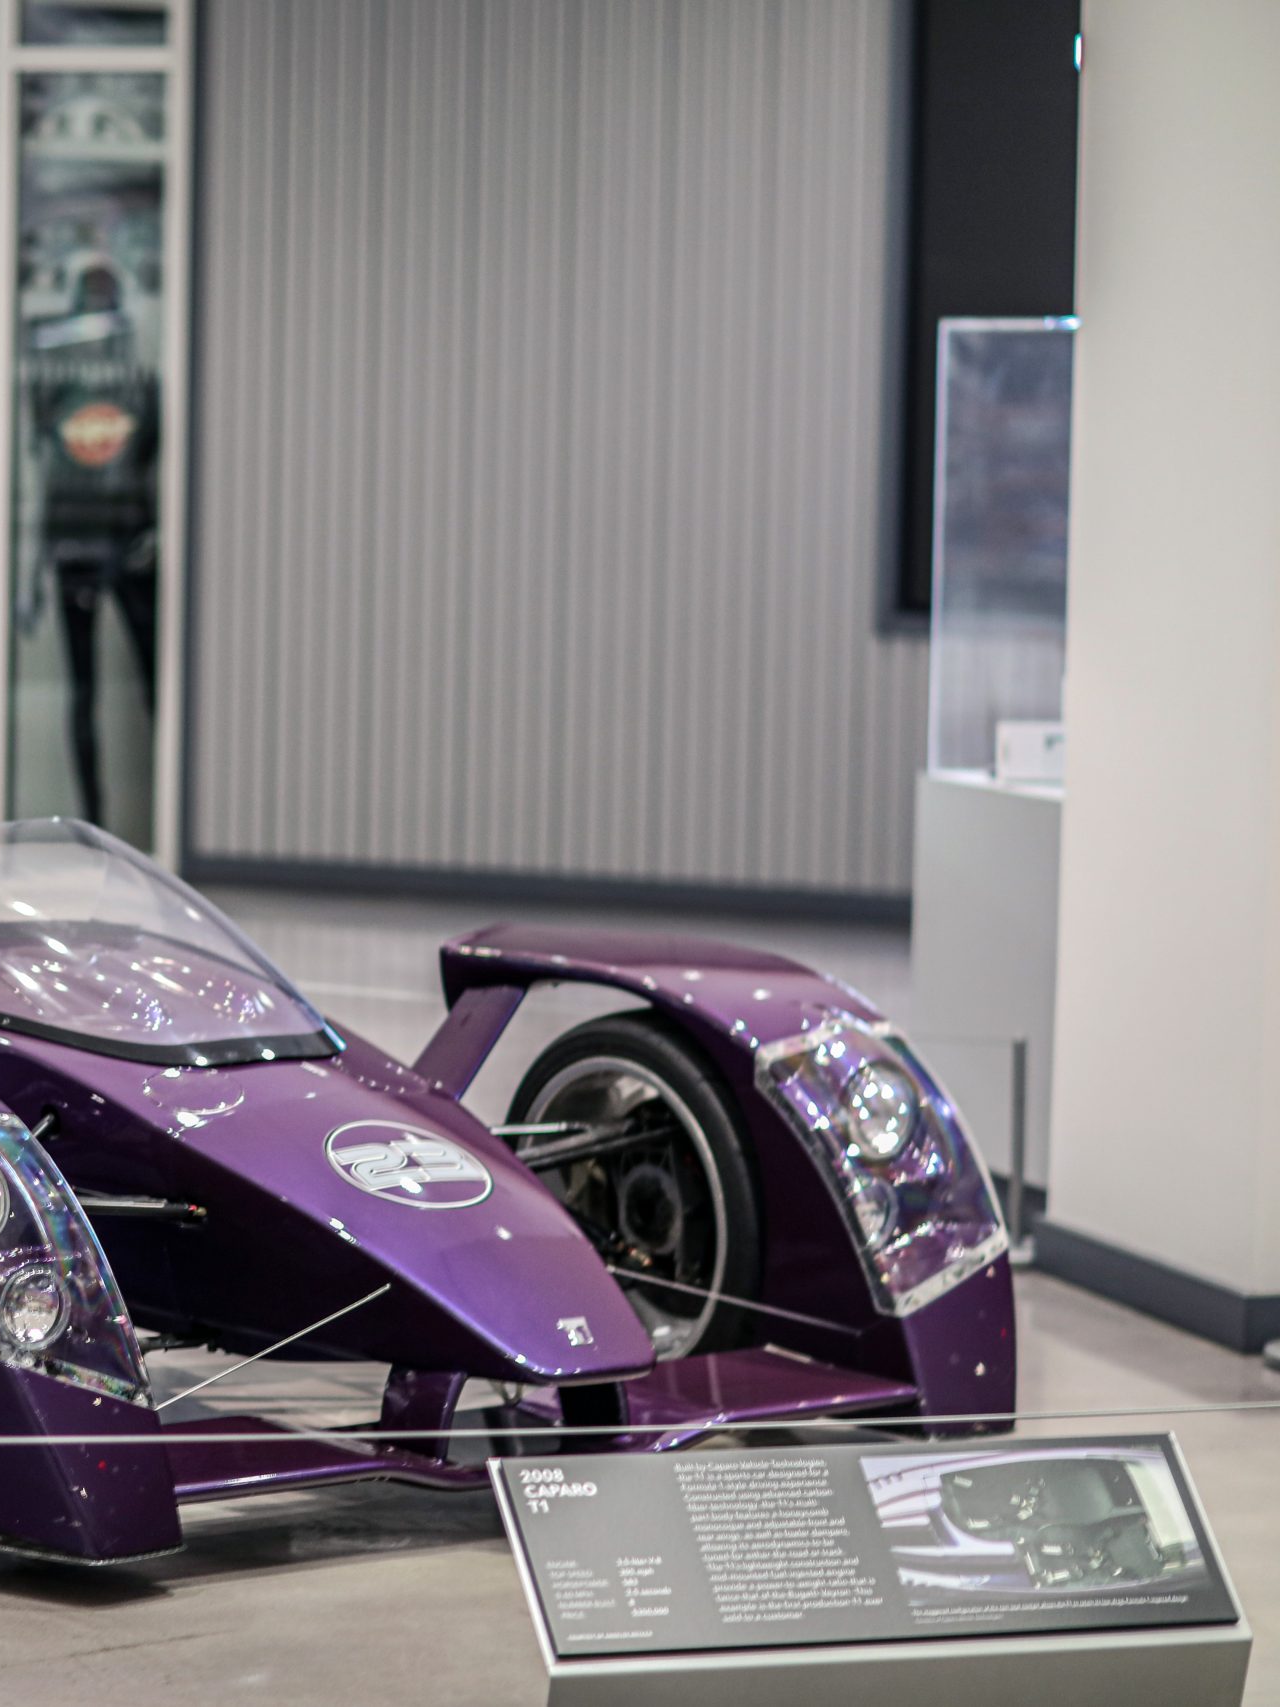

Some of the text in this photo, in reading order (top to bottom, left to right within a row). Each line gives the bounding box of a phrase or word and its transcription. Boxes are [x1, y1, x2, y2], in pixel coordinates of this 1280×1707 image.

[519, 1467, 565, 1483] 2008
[524, 1481, 598, 1498] CAPARO
[526, 1499, 550, 1514] T1
